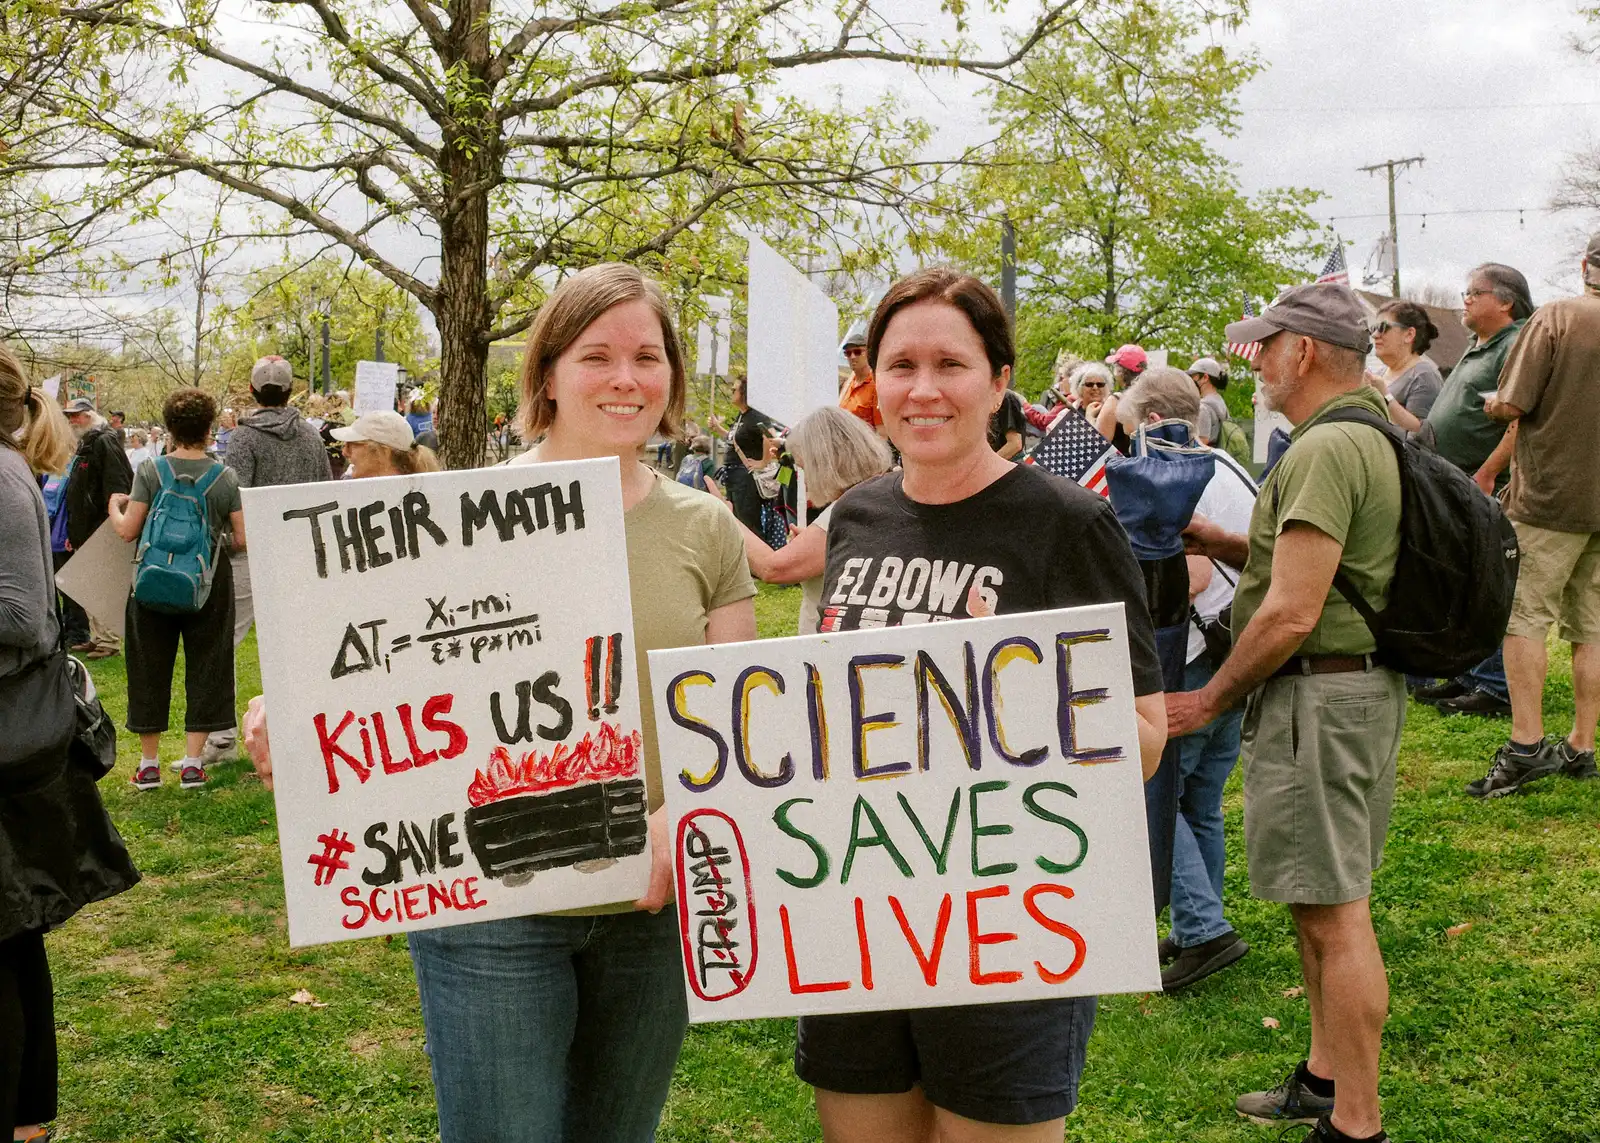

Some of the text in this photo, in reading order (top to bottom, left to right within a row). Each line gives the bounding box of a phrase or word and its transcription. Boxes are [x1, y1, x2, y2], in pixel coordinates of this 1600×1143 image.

[283, 480, 585, 578] THEIR MATH
[829, 557, 1004, 617] ELBOWS
[666, 629, 1127, 793] SCIENCE
[772, 780, 1089, 888] SAVES
[340, 876, 487, 930] SCIENCE
[686, 830, 743, 988] TRUMP
[779, 884, 1086, 995] LIVES
